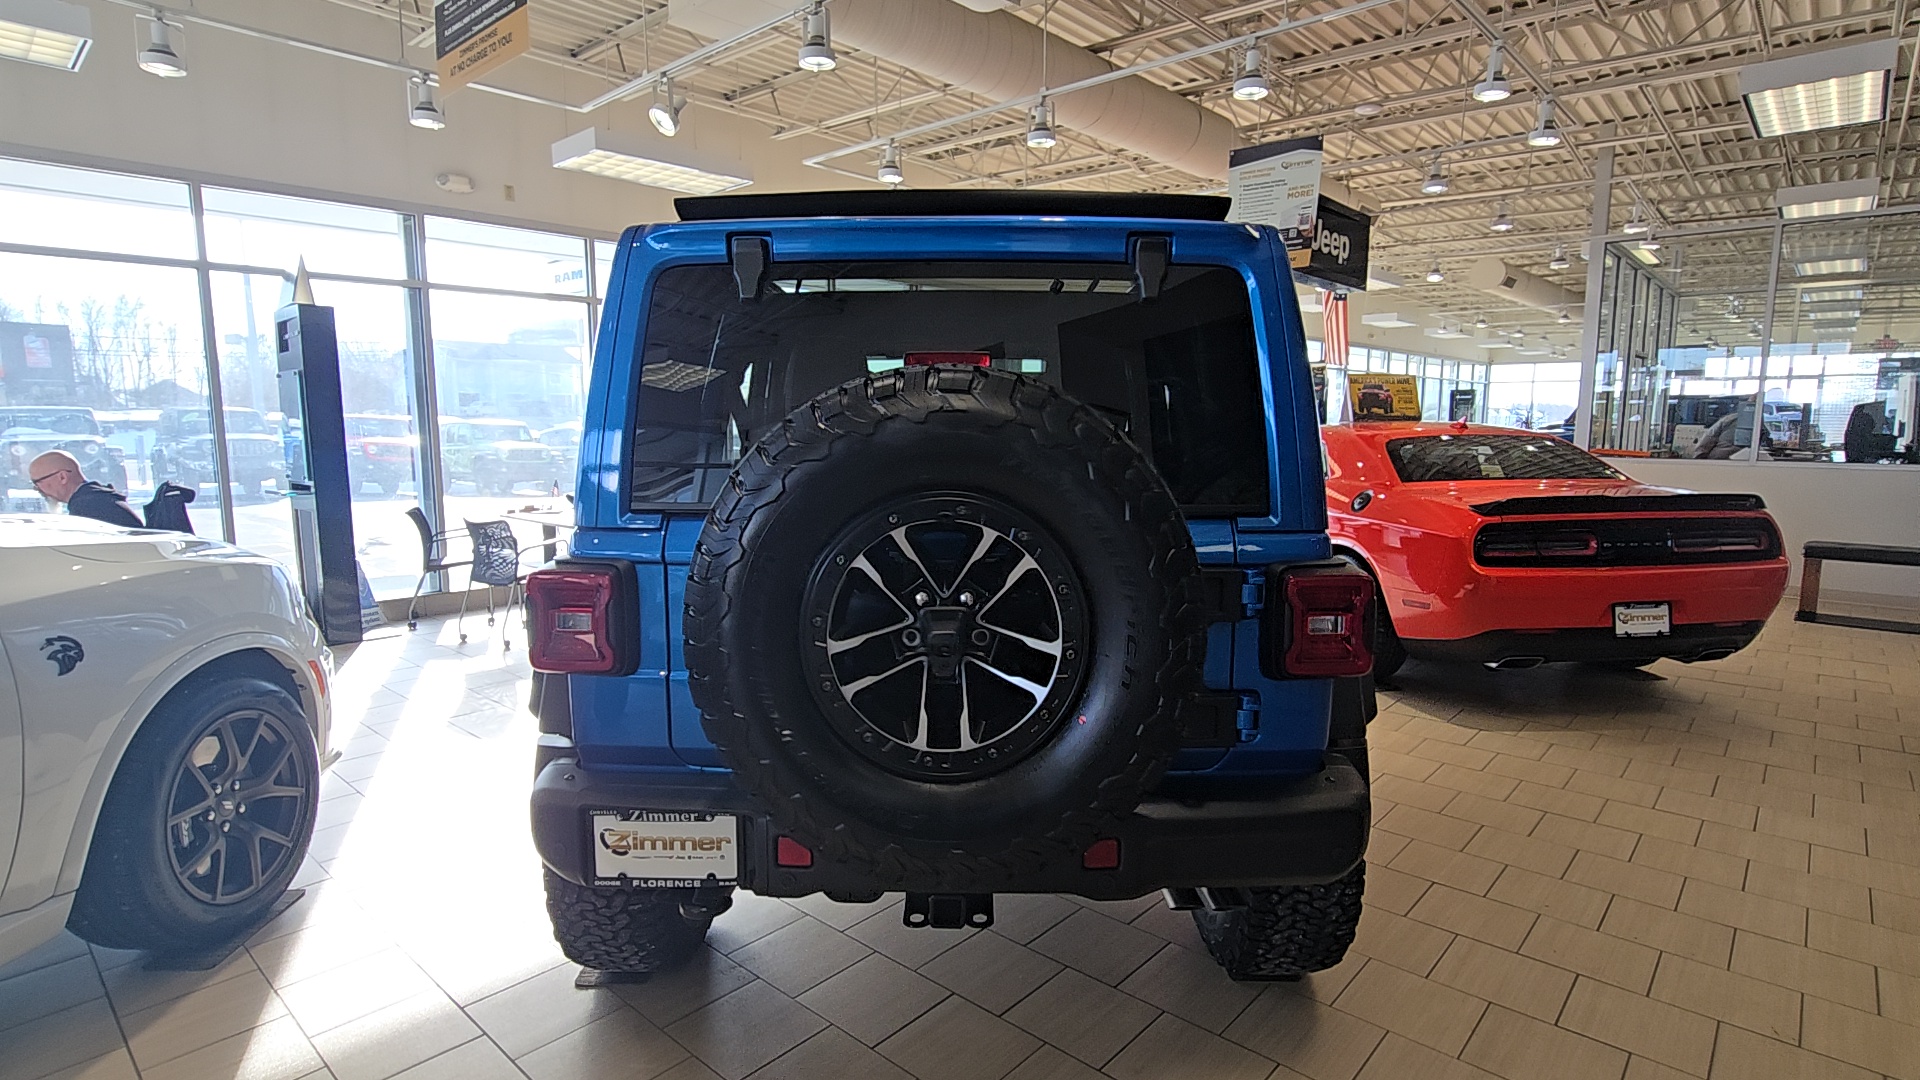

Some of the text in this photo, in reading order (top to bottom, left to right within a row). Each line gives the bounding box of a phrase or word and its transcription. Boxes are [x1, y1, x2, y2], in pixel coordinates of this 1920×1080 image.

[457, 60, 465, 72] NO
[465, 47, 488, 68] CHARGE
[488, 42, 497, 54] TO
[1287, 189, 1314, 200] MORE!
[1311, 218, 1350, 265] Jeep
[554, 269, 583, 283] RAM
[629, 809, 698, 822] Zimmer
[606, 830, 731, 852] Zimmer
[632, 879, 702, 888] FLORENCE
